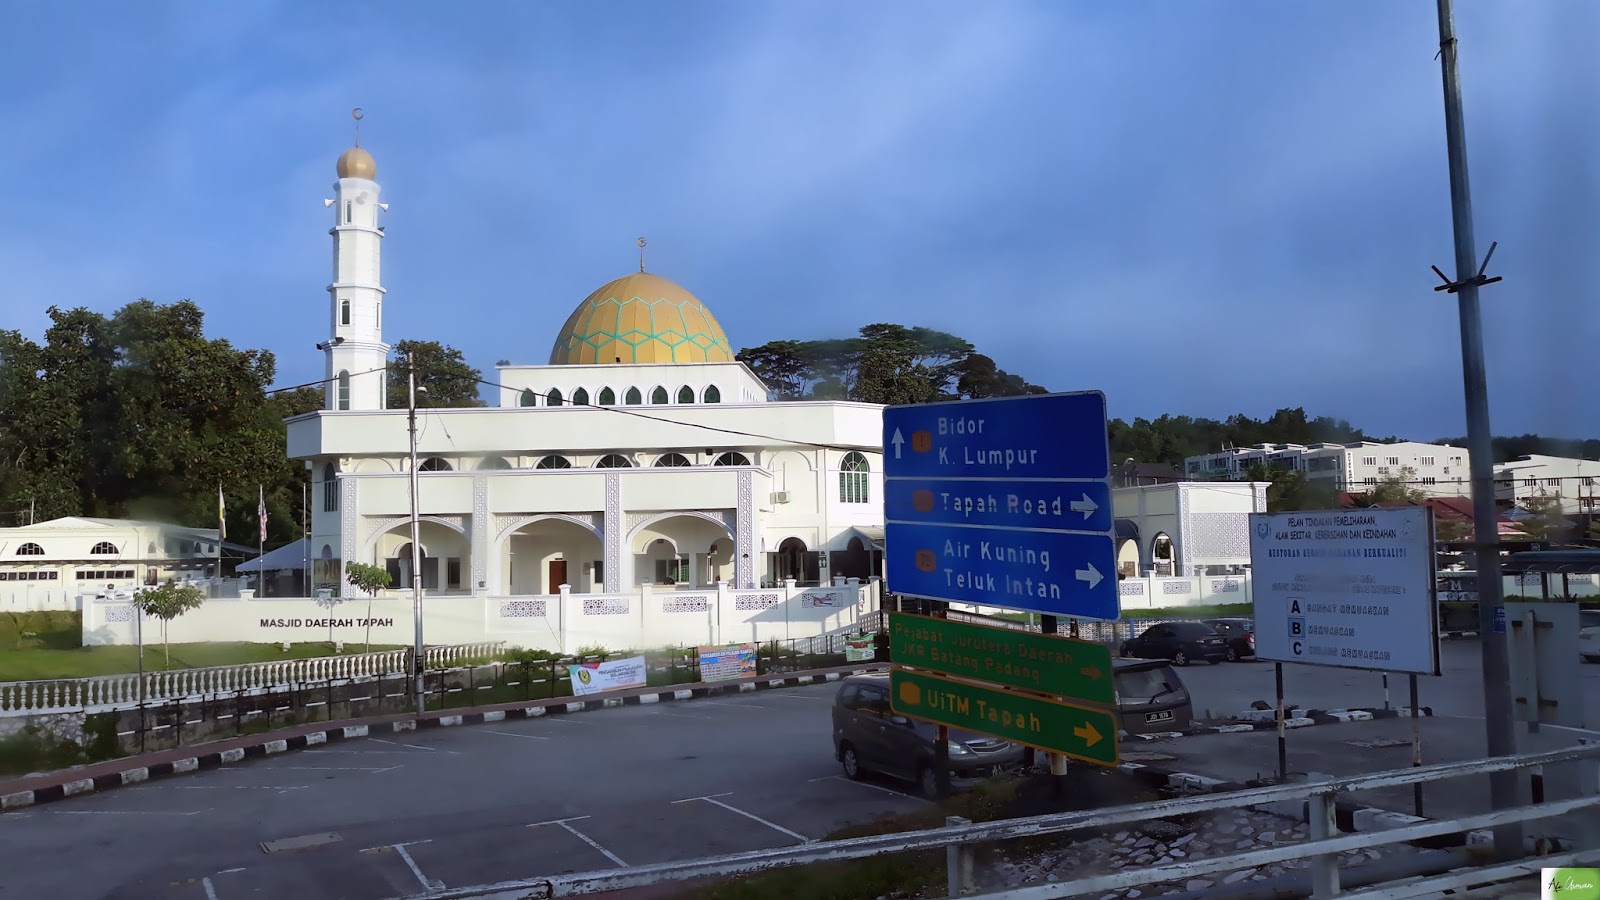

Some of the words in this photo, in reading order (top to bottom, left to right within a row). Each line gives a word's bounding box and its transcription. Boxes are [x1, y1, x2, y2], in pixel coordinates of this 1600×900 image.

[938, 417, 985, 435] Bidor
[939, 447, 956, 465] K.
[965, 446, 1038, 470] Lumpur
[941, 492, 998, 517] Tapah
[1007, 494, 1062, 516] Road
[1350, 529, 1361, 539] DAN
[943, 539, 971, 559] Air
[981, 541, 1050, 572] Kuning
[1268, 548, 1301, 558] RESTORAN
[944, 568, 996, 592] Teluk
[1006, 574, 1061, 600] Intan
[1291, 600, 1301, 614] A
[260, 618, 301, 628] MASJID
[305, 618, 353, 628] DAERAH
[356, 618, 393, 628] TAPAH
[1292, 621, 1302, 635] B
[895, 622, 943, 644] Pejabat
[952, 632, 1011, 656] Jurutera
[1019, 643, 1073, 665] Daerah
[1292, 641, 1303, 656] C
[902, 642, 925, 657] JKR
[931, 648, 979, 672] Batang
[985, 658, 1041, 684] Padang
[928, 690, 970, 717] UiTM
[977, 700, 1041, 733] Tapah
